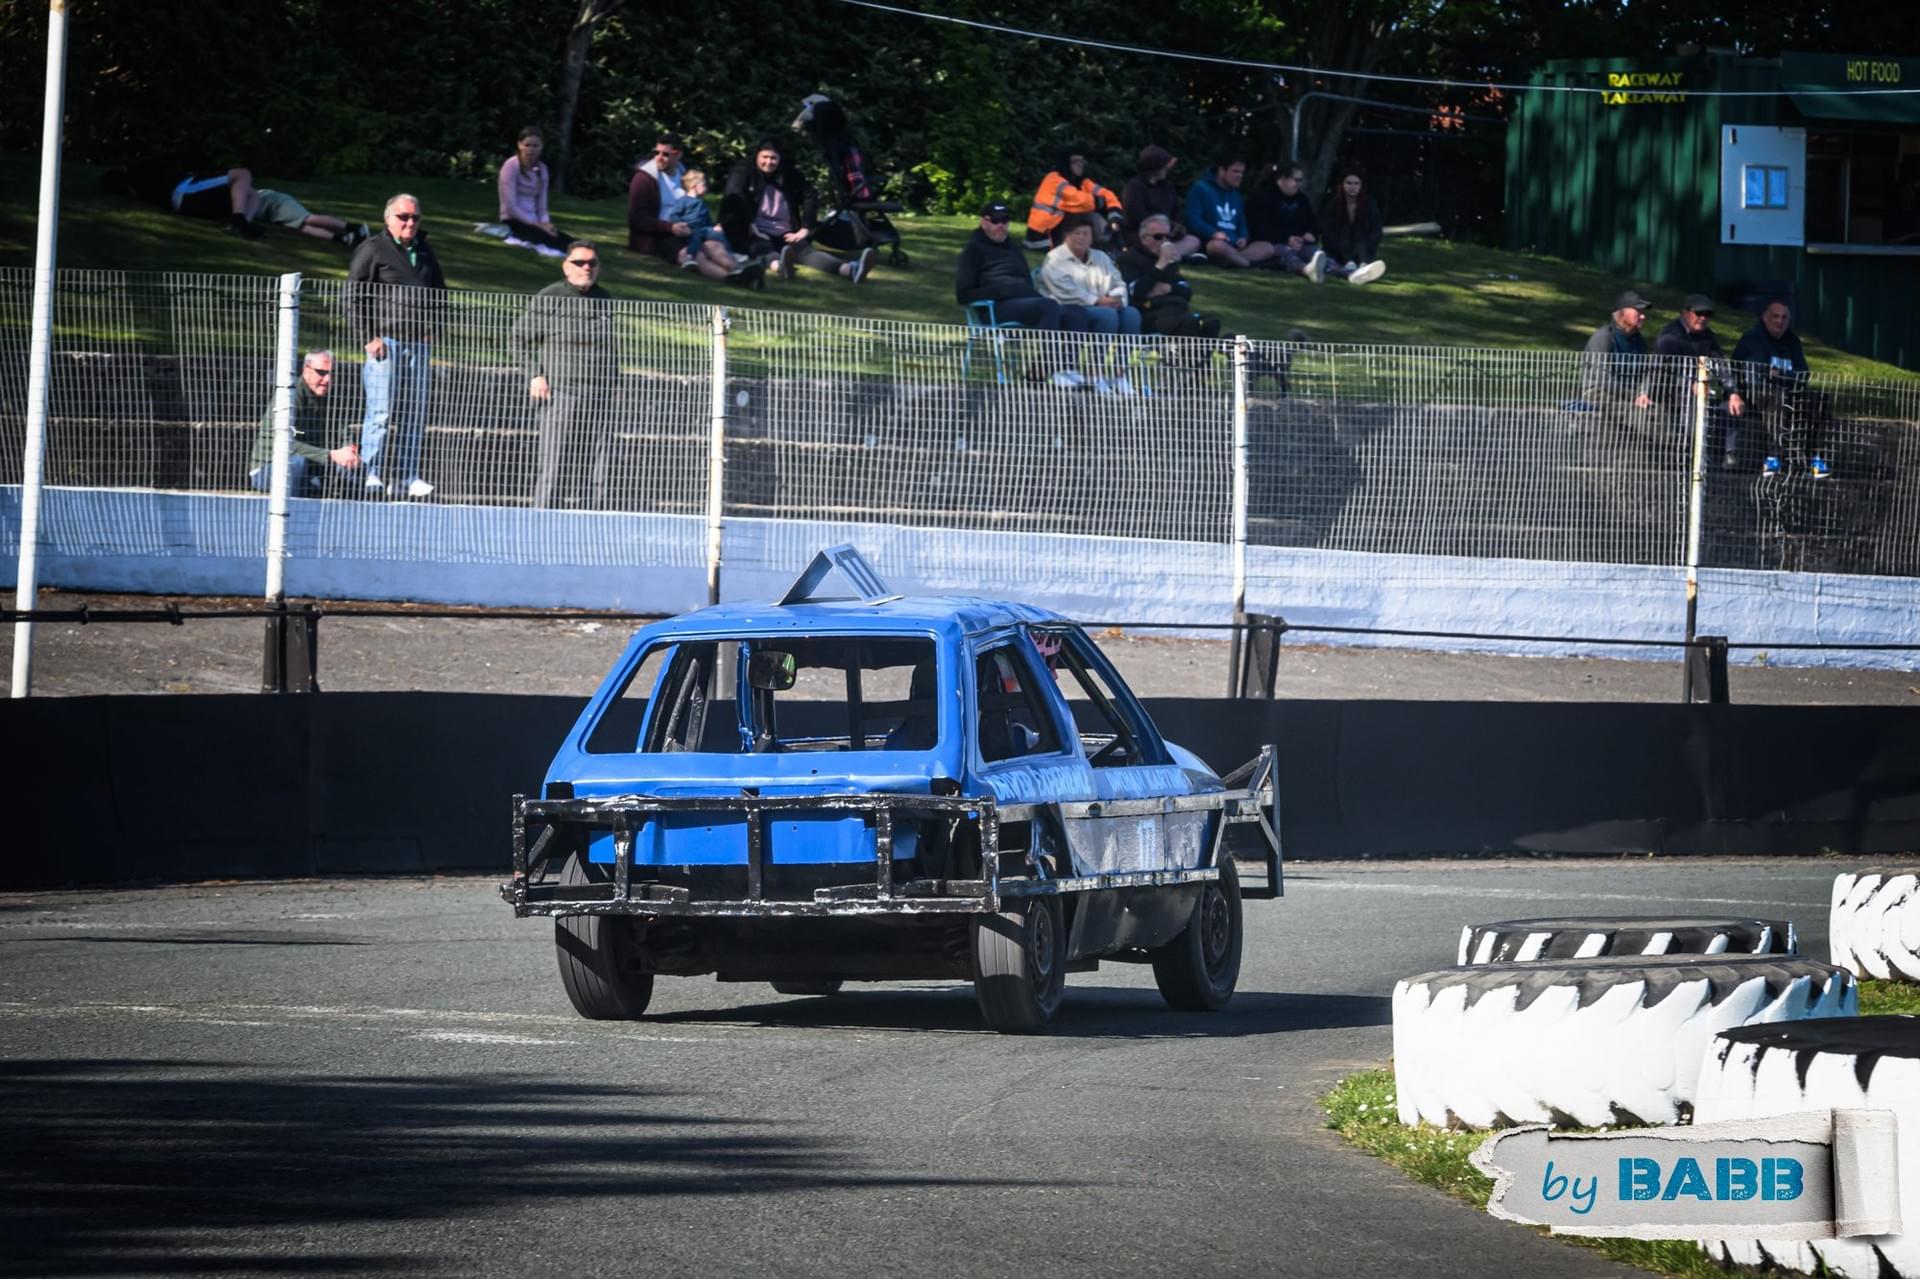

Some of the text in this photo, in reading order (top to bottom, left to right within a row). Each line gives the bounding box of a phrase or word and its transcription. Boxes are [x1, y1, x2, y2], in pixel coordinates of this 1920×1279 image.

[1847, 60, 1901, 83] HOT FOOD
[1608, 73, 1684, 88] RACEWAY
[1601, 89, 1687, 105] TAKEAWAY
